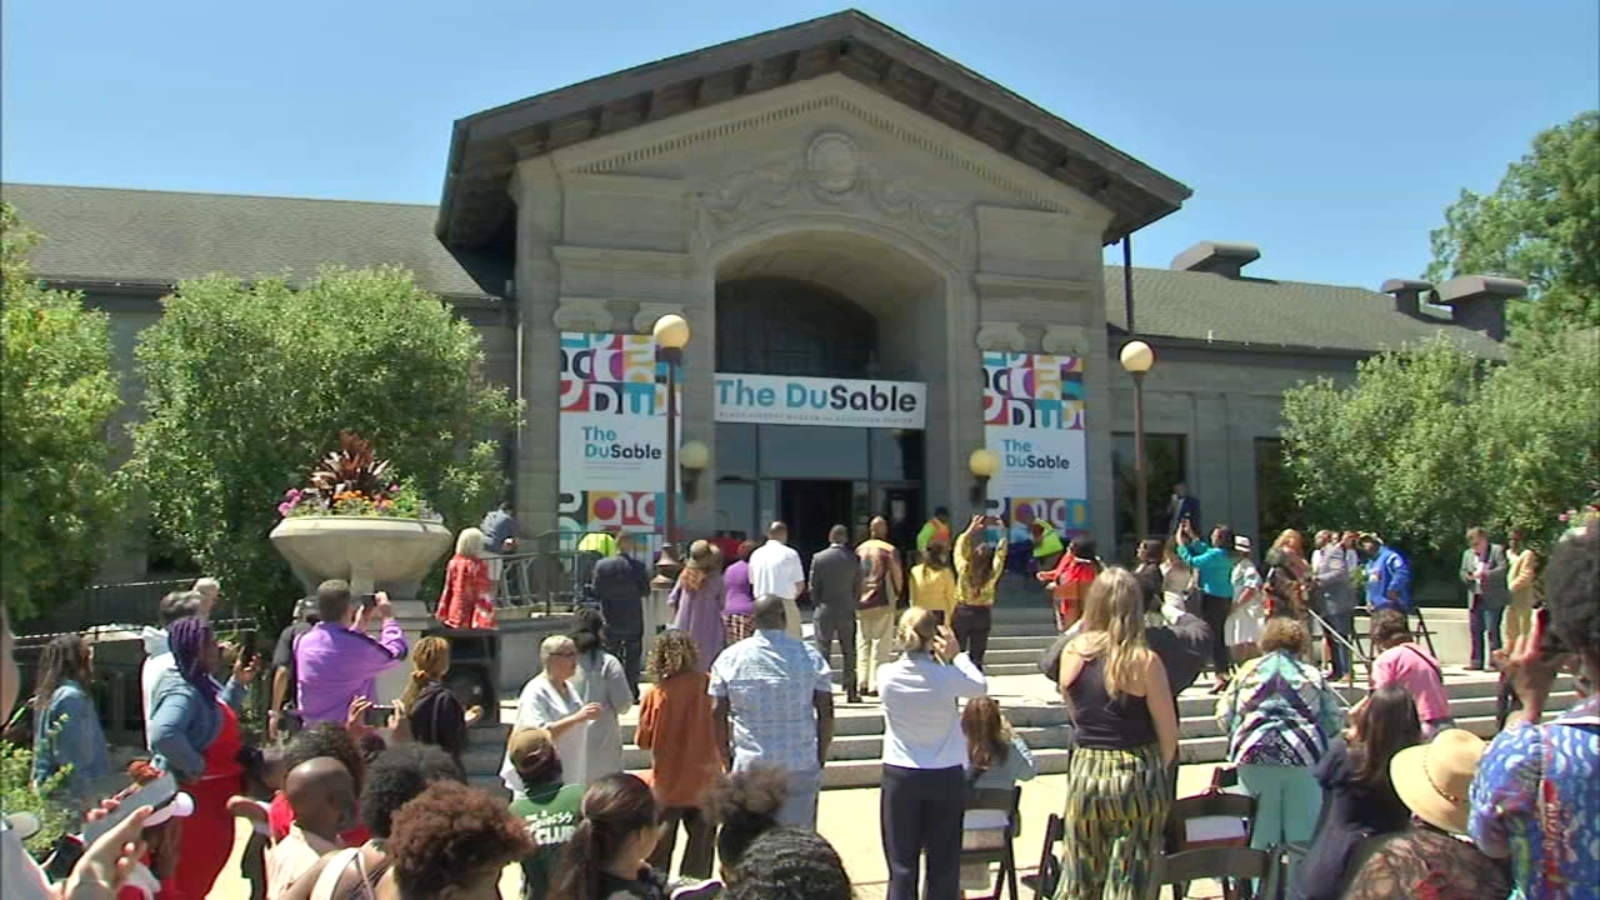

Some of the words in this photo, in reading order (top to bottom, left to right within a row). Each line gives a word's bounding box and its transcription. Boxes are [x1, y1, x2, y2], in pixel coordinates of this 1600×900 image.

[716, 379, 775, 407] The
[786, 382, 917, 412] DuSable
[582, 425, 617, 441] The
[585, 443, 662, 460] DuSable
[1003, 438, 1032, 452] The
[1006, 454, 1070, 470] DuSable
